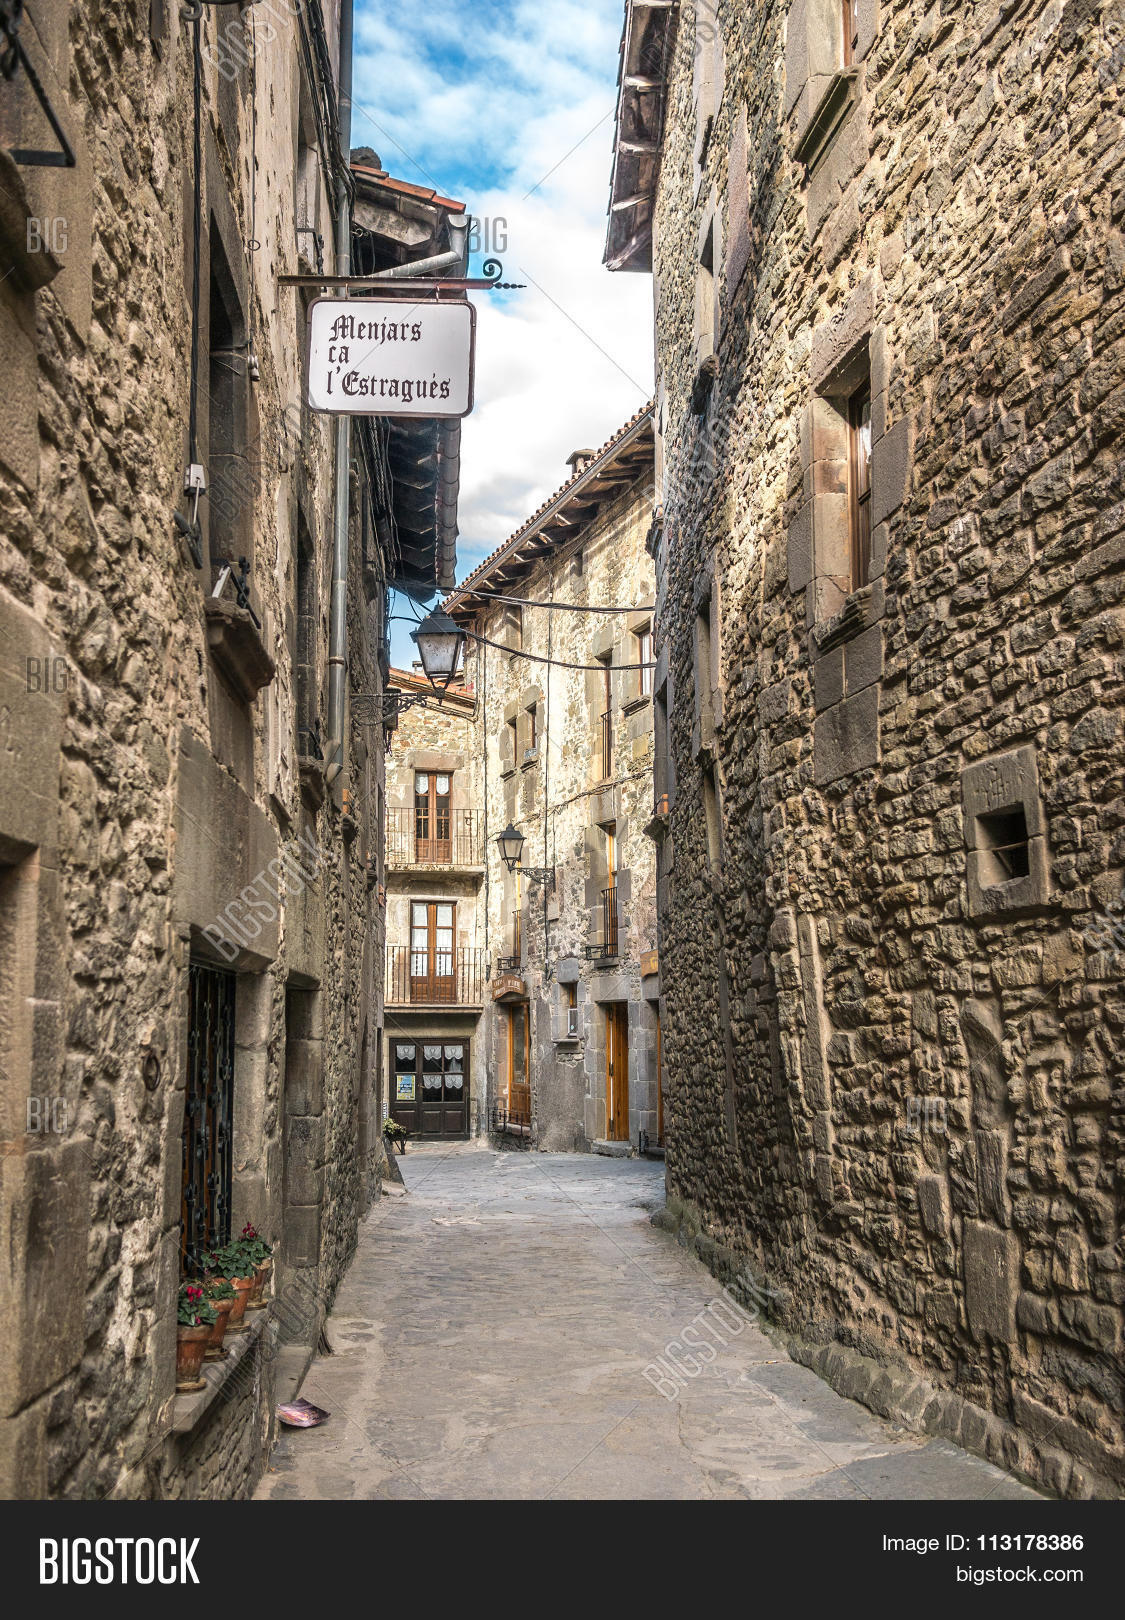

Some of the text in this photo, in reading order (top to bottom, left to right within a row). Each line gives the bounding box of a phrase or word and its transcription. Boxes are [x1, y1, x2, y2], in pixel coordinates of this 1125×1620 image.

[328, 314, 423, 345] Menjars
[327, 345, 350, 364] ca
[326, 365, 451, 403] l'Estragués
